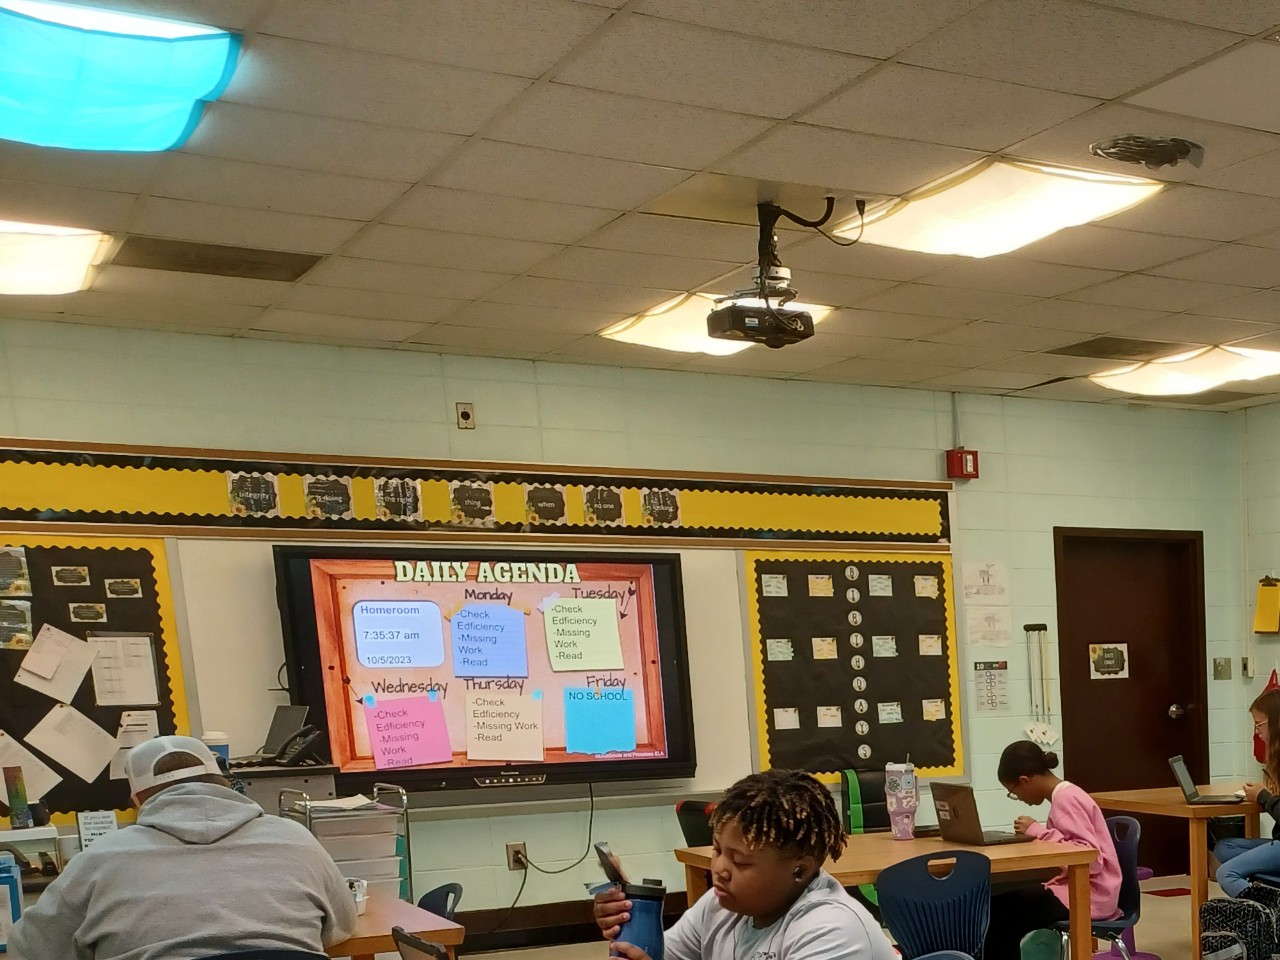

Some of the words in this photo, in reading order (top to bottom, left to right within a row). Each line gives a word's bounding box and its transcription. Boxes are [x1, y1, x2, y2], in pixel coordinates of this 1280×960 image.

[464, 499, 481, 508] thing
[394, 561, 469, 582] DAILY
[477, 562, 582, 584] AGENDA
[464, 587, 513, 606] Monday
[572, 584, 626, 606] Tuesday
[360, 605, 420, 615] Homeroom
[456, 609, 490, 619] -Check
[551, 604, 583, 613] -Check
[457, 621, 505, 633] Edficiency
[552, 616, 598, 627] Edficiency
[363, 630, 401, 640] 7:35:37
[403, 632, 420, 640] am
[553, 628, 591, 639] -Missing
[458, 634, 497, 645] -Missing
[554, 640, 578, 648] Work
[458, 645, 483, 655] Work
[555, 651, 583, 660] -Read
[366, 655, 412, 665] 10/5/2023
[459, 657, 488, 667] -Read
[371, 677, 448, 700] Wednesday
[463, 674, 525, 697] Thursday
[586, 672, 627, 697] Friday
[569, 691, 585, 701] NO
[586, 691, 628, 701] SCHOOL
[473, 697, 505, 707] -Check
[374, 708, 408, 720] -Check
[472, 709, 520, 720] Edficiency
[375, 720, 425, 732] Edficiency
[473, 721, 512, 732] -Missing
[514, 721, 539, 730] Work
[379, 732, 420, 744] -Missing
[474, 733, 503, 742] -Read
[380, 746, 407, 756] Work
[384, 756, 414, 767] -Read
